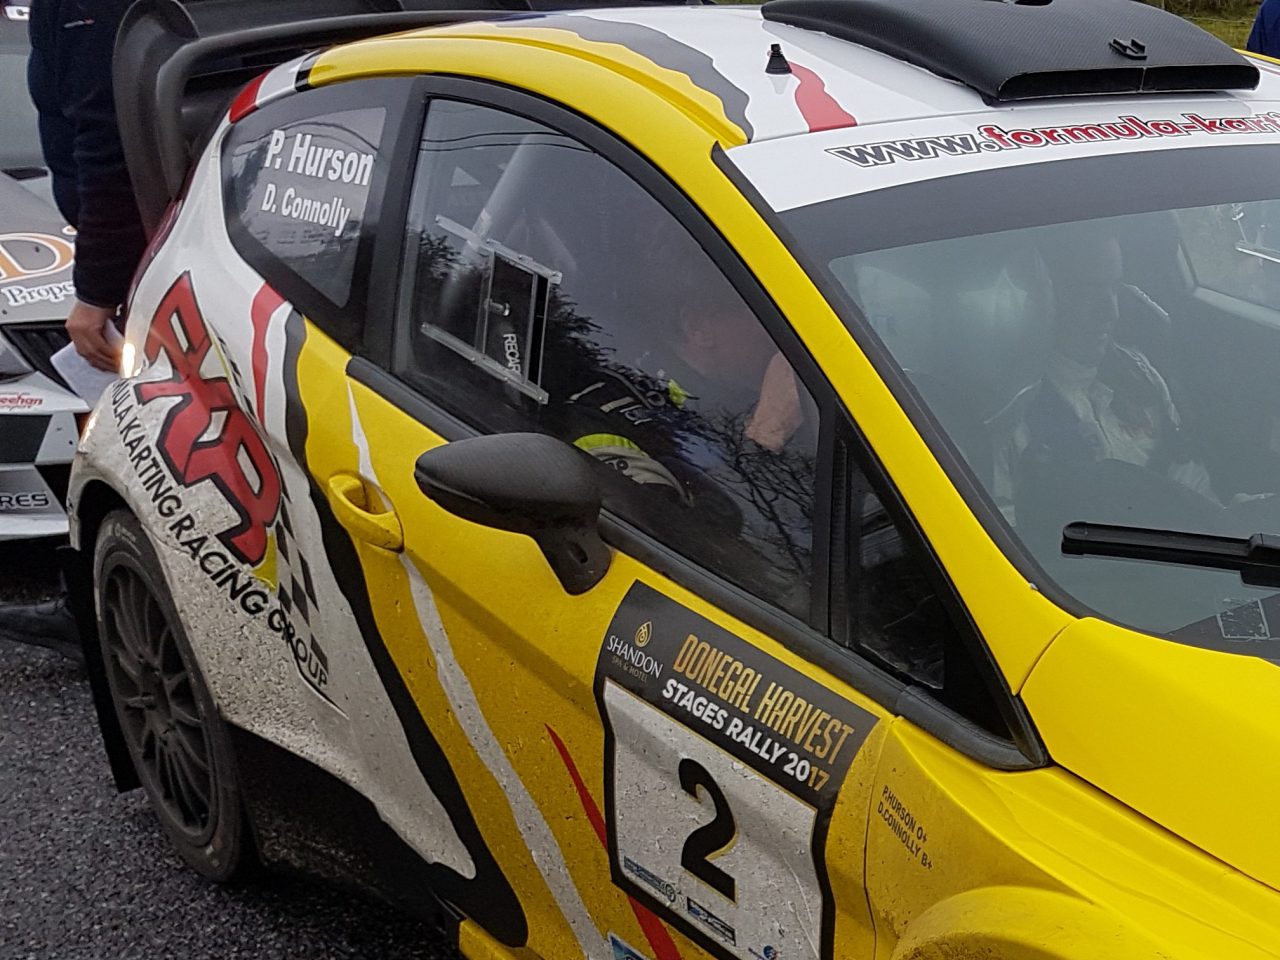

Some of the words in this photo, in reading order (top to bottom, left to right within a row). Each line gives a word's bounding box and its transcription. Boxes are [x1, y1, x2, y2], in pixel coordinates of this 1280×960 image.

[264, 129, 286, 169] P.
[287, 133, 375, 186] Hurson
[261, 183, 277, 213] D.
[281, 187, 351, 237] Connolly
[119, 416, 183, 518] KARTING
[169, 513, 269, 615] RACING
[267, 608, 329, 688] GROUP
[606, 635, 664, 679] SHANDON
[672, 633, 763, 714] DONEGAL
[662, 678, 729, 731] STAGES
[725, 717, 788, 765] RALLY
[783, 752, 830, 792] 2017
[753, 681, 855, 766] HARVEST
[678, 758, 738, 904] 2
